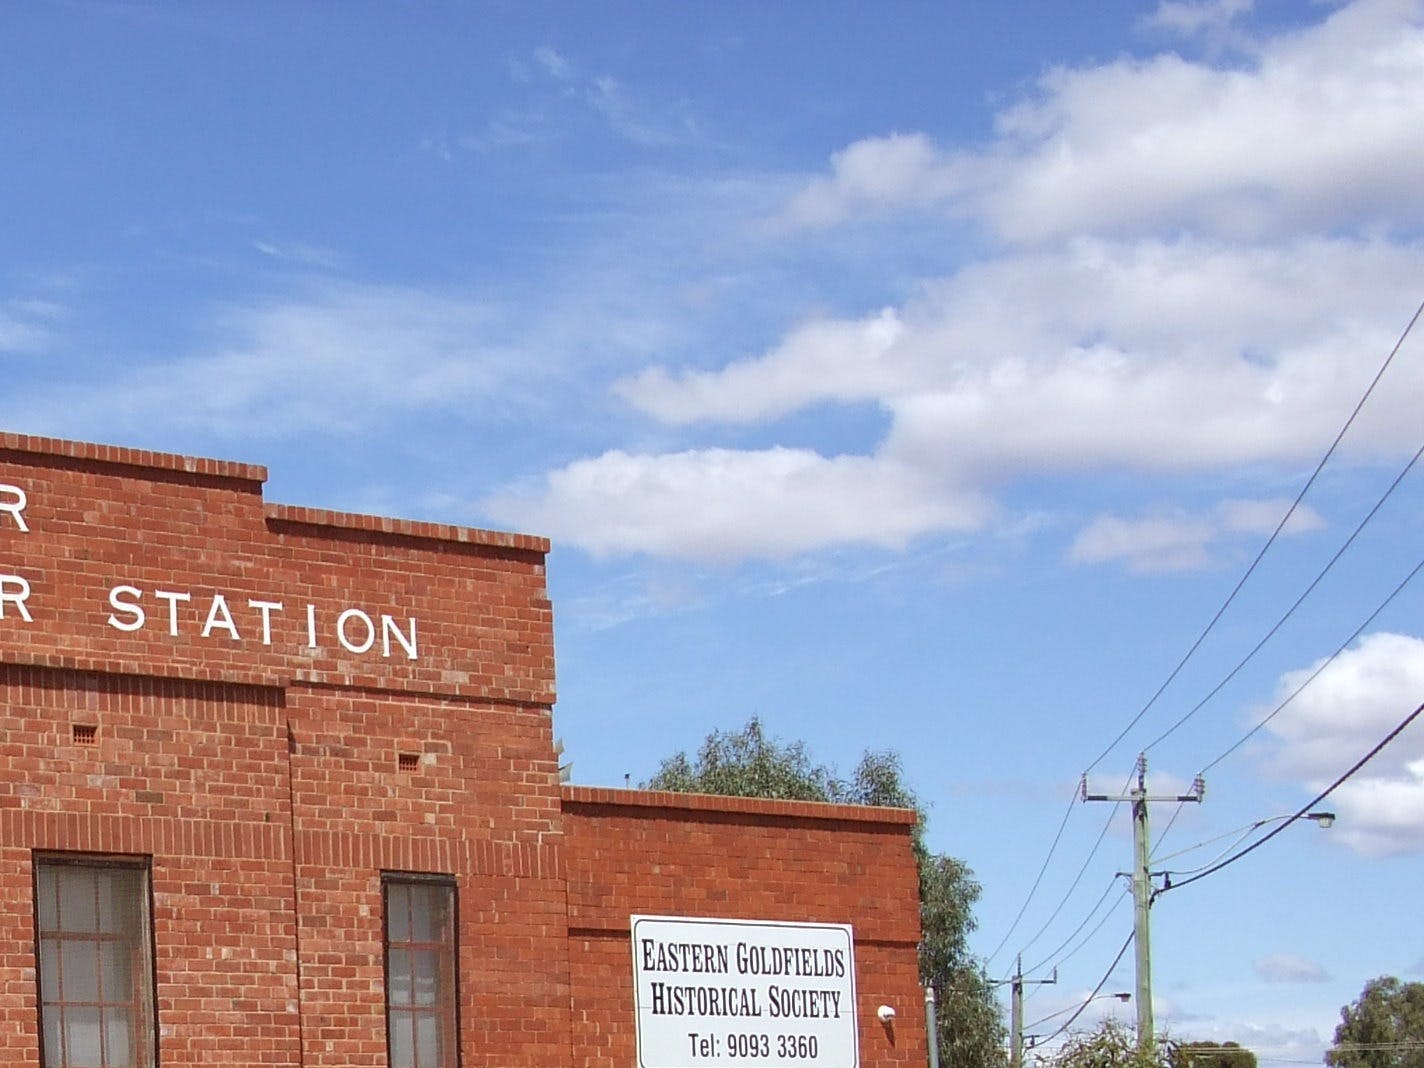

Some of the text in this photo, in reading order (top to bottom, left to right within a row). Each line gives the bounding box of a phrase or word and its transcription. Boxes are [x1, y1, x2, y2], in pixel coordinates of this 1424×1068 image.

[107, 585, 419, 660] STATION
[642, 939, 845, 978] EASTERN GOLDFIELDS
[651, 982, 841, 1019] HISTORICAL SOCIETY
[688, 1033, 818, 1058] Tel: 9093 3360
